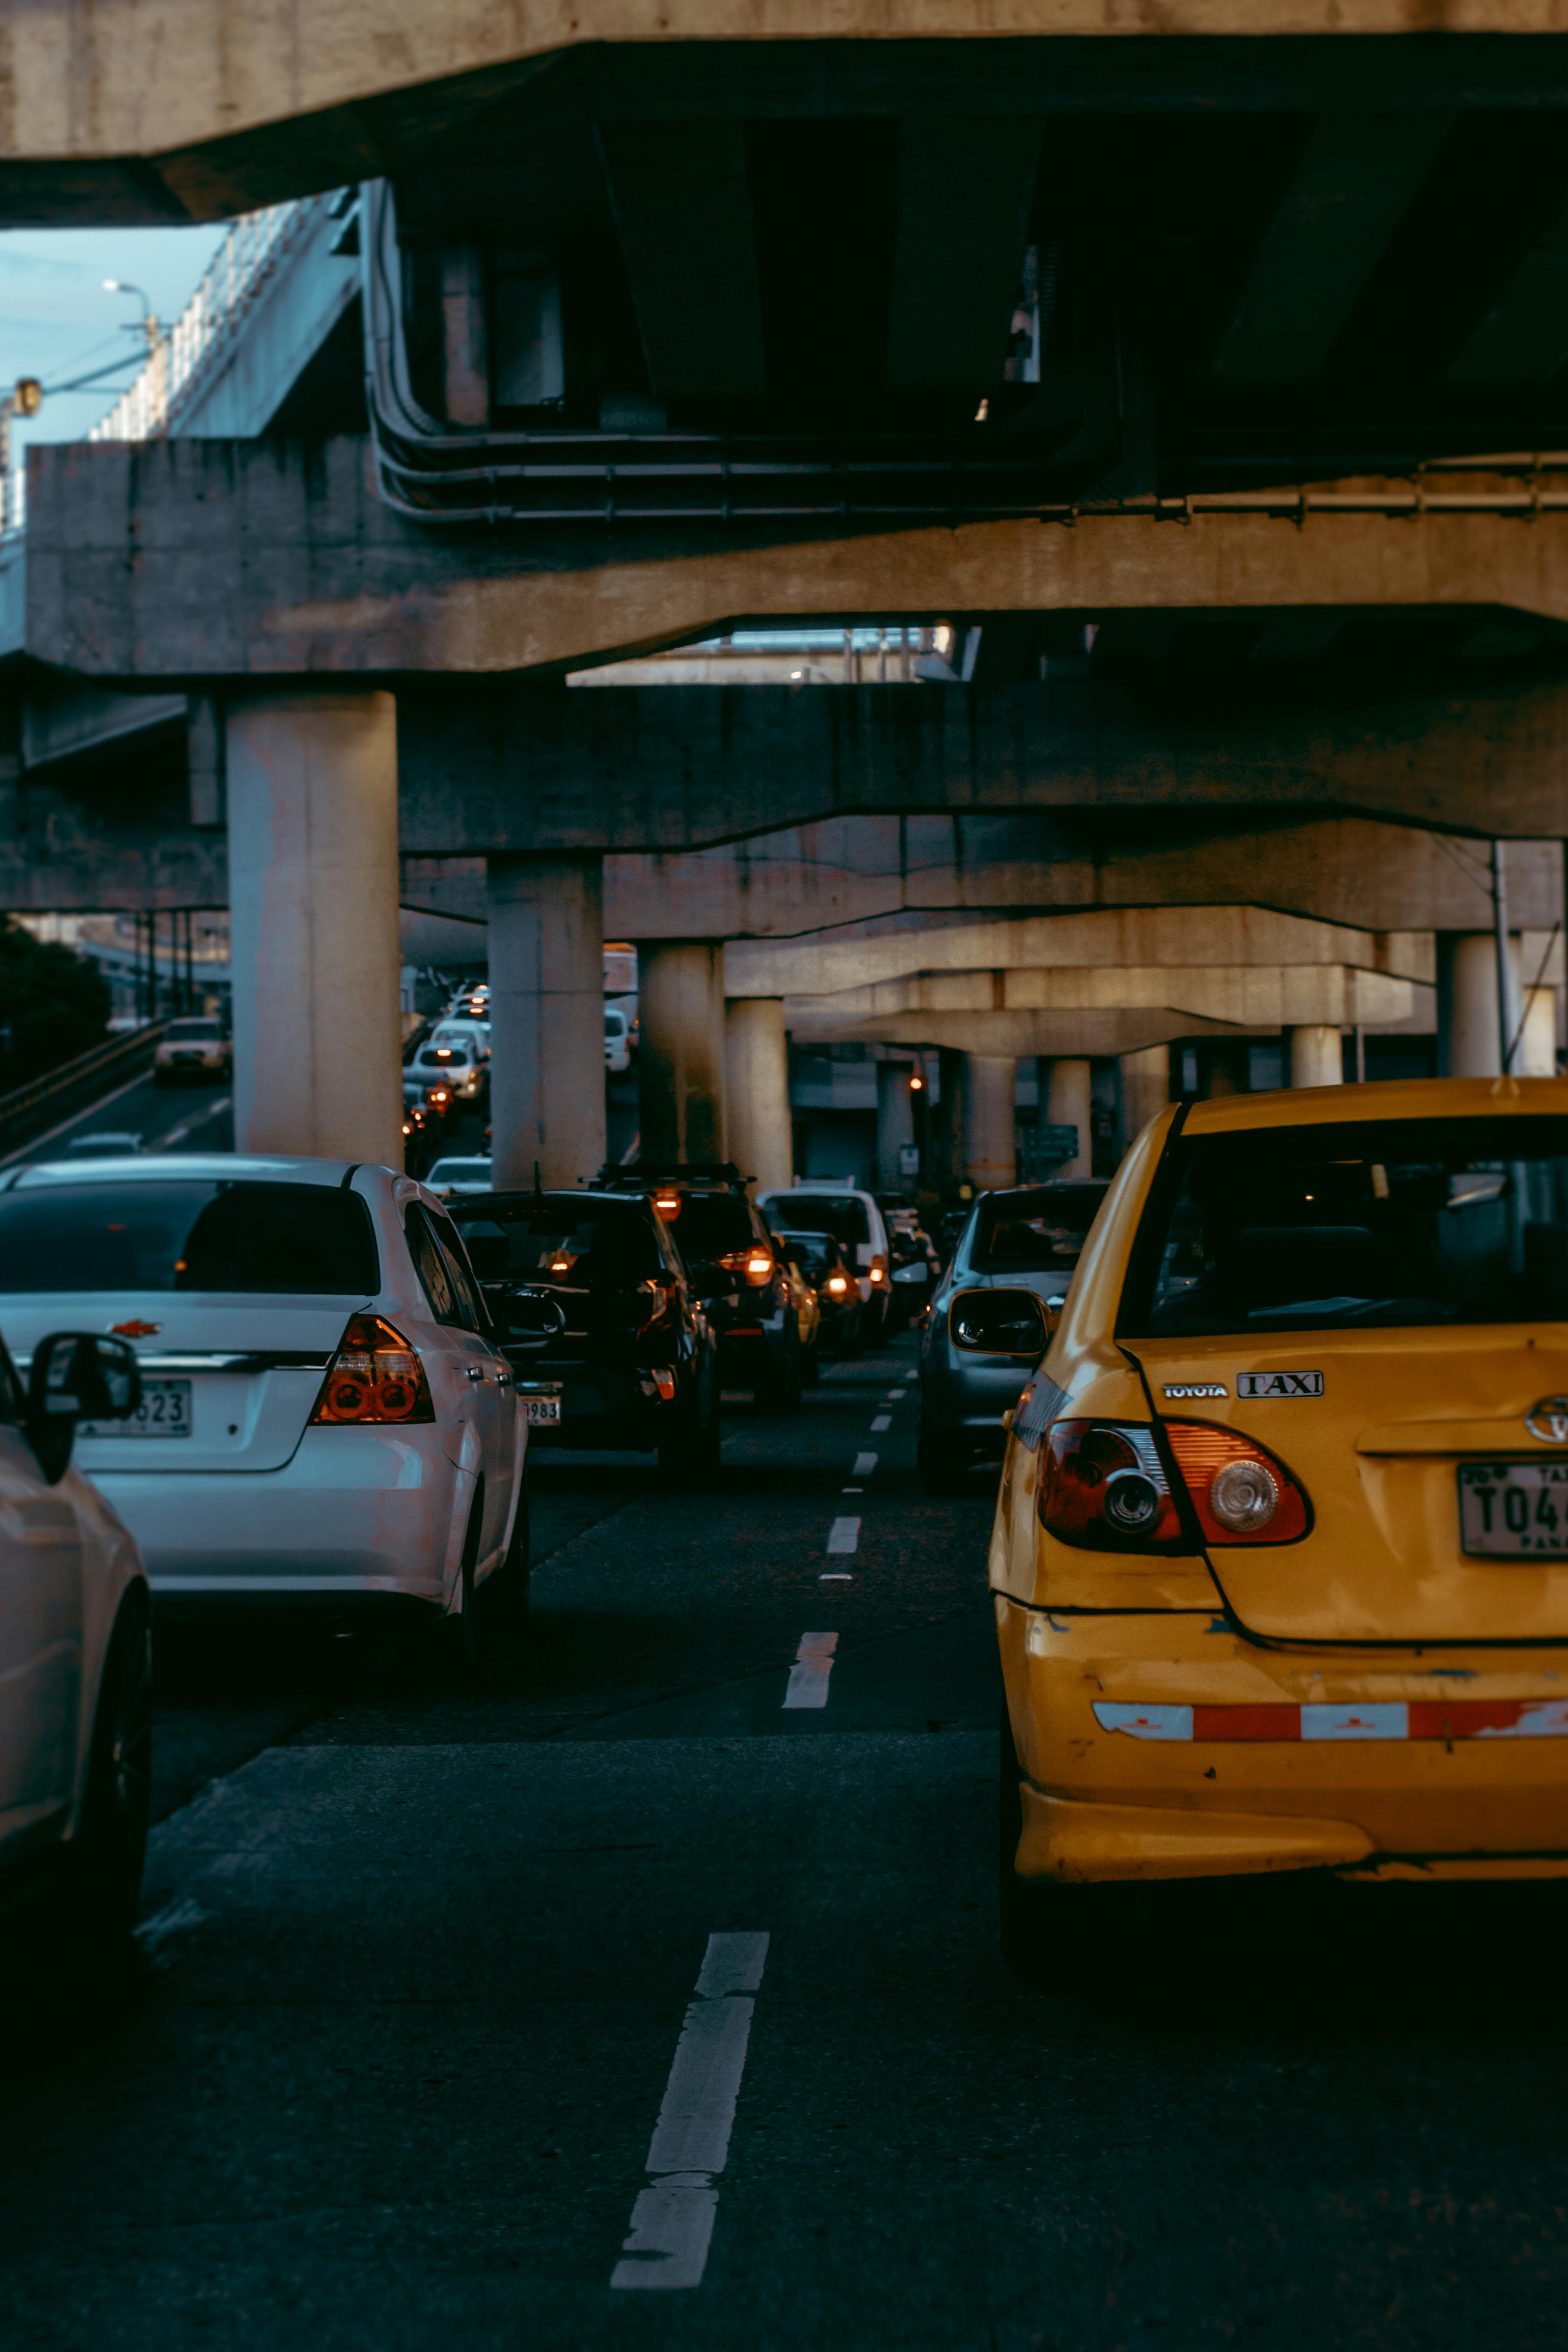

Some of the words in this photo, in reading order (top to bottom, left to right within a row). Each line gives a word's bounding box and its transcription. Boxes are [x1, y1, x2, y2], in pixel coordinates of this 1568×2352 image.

[1162, 1385, 1227, 1398] TOYOTA
[1240, 1374, 1321, 1394] TAXI
[1474, 1487, 1568, 1532] T04
